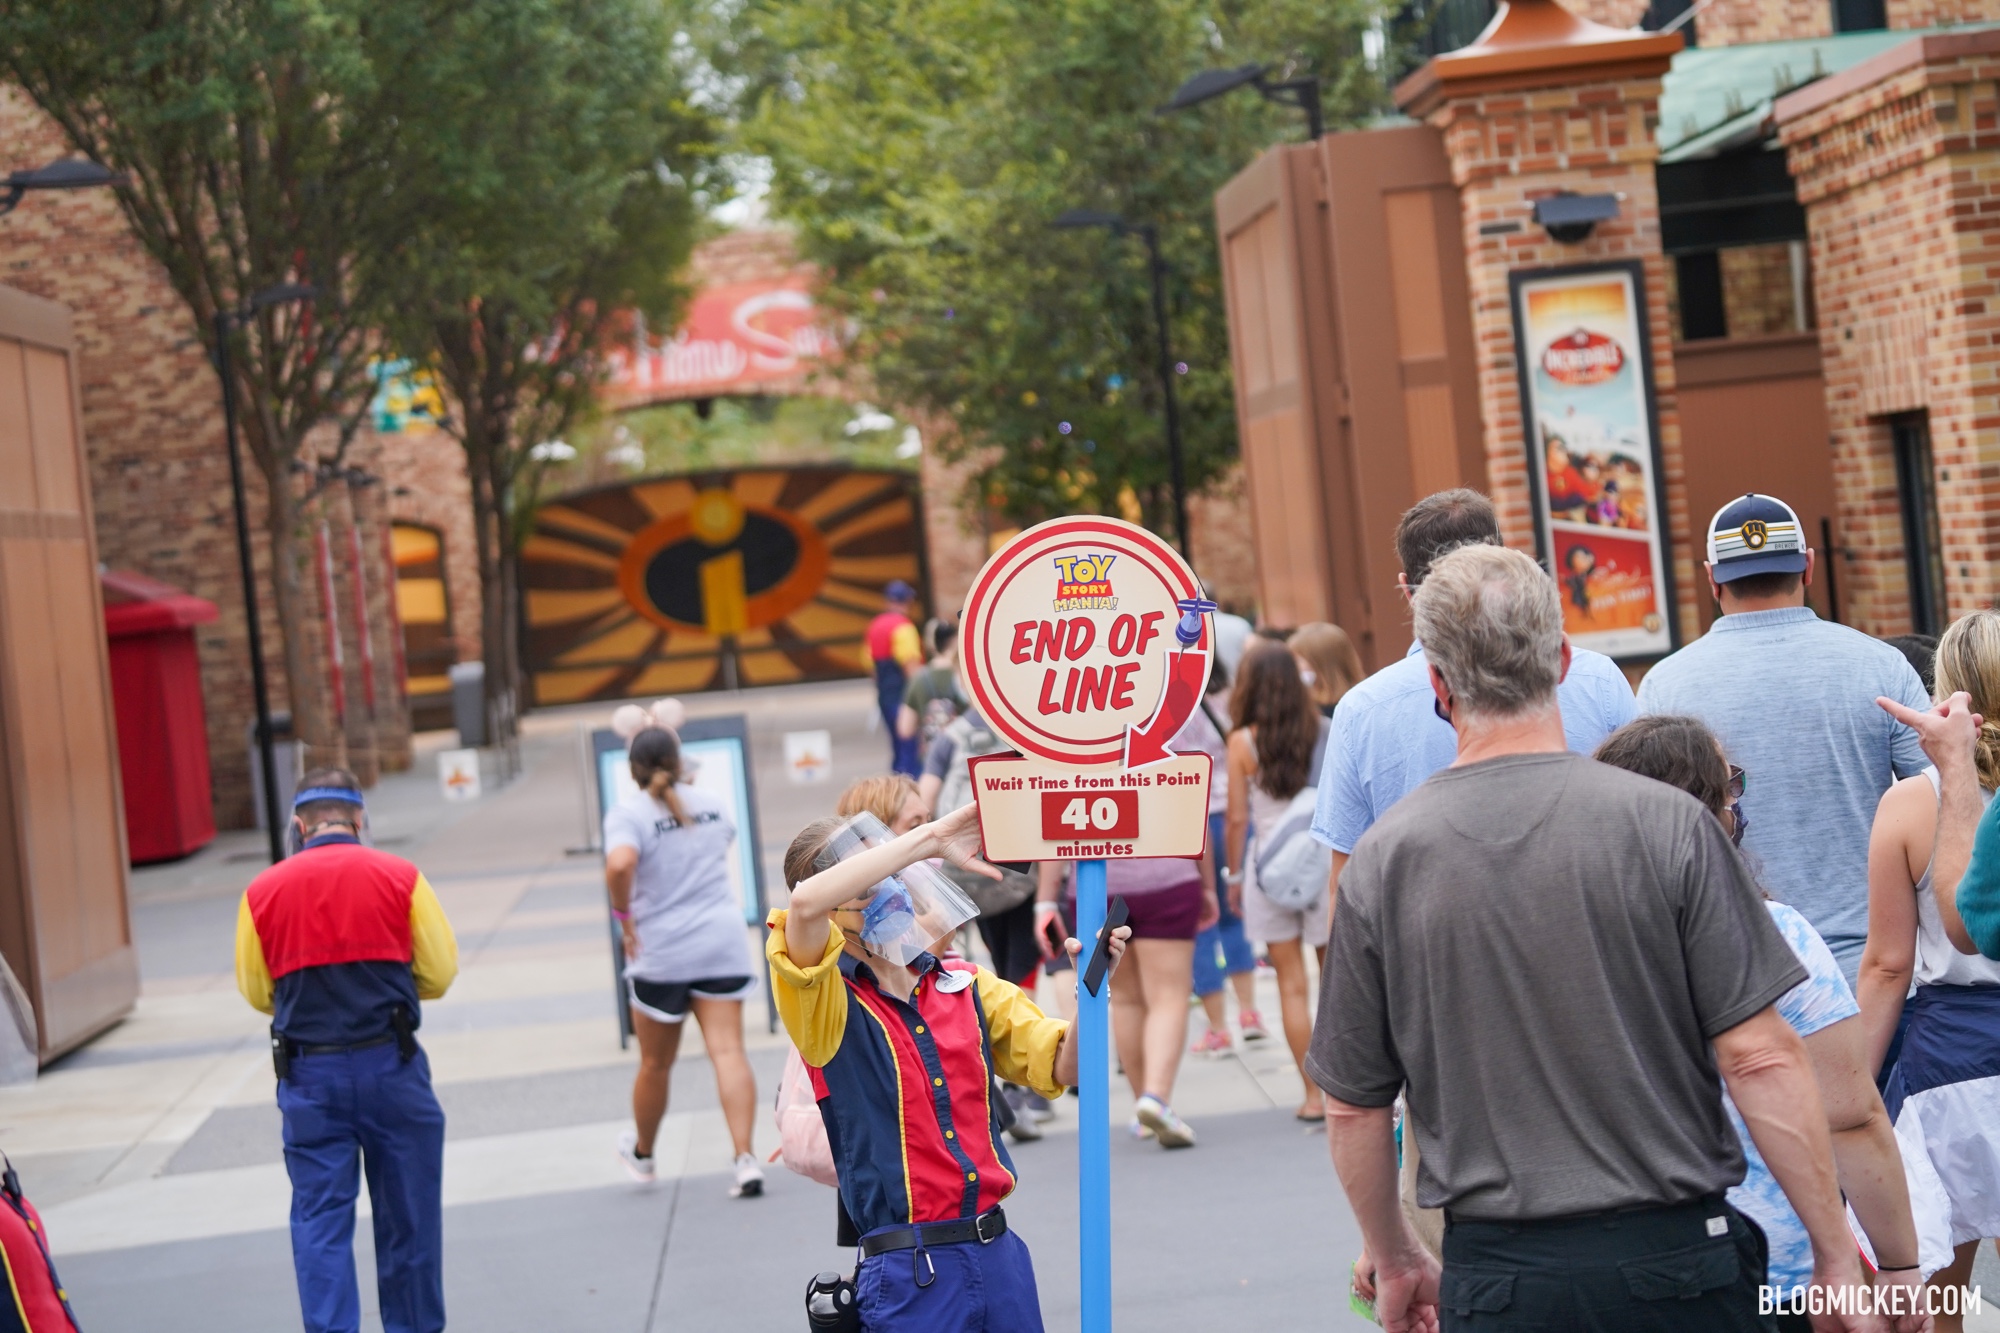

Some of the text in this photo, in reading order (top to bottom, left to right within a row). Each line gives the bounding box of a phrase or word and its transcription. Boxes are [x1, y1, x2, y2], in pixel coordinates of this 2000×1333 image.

[1053, 553, 1118, 586] TOY
[1062, 584, 1108, 595] STORY
[1052, 596, 1119, 613] MANIA!
[1010, 610, 1165, 665] END OF
[1037, 661, 1141, 716] LINE
[985, 772, 1201, 791] Wait Time from this Point
[1060, 797, 1119, 831] 40
[1056, 840, 1134, 857] minutes
